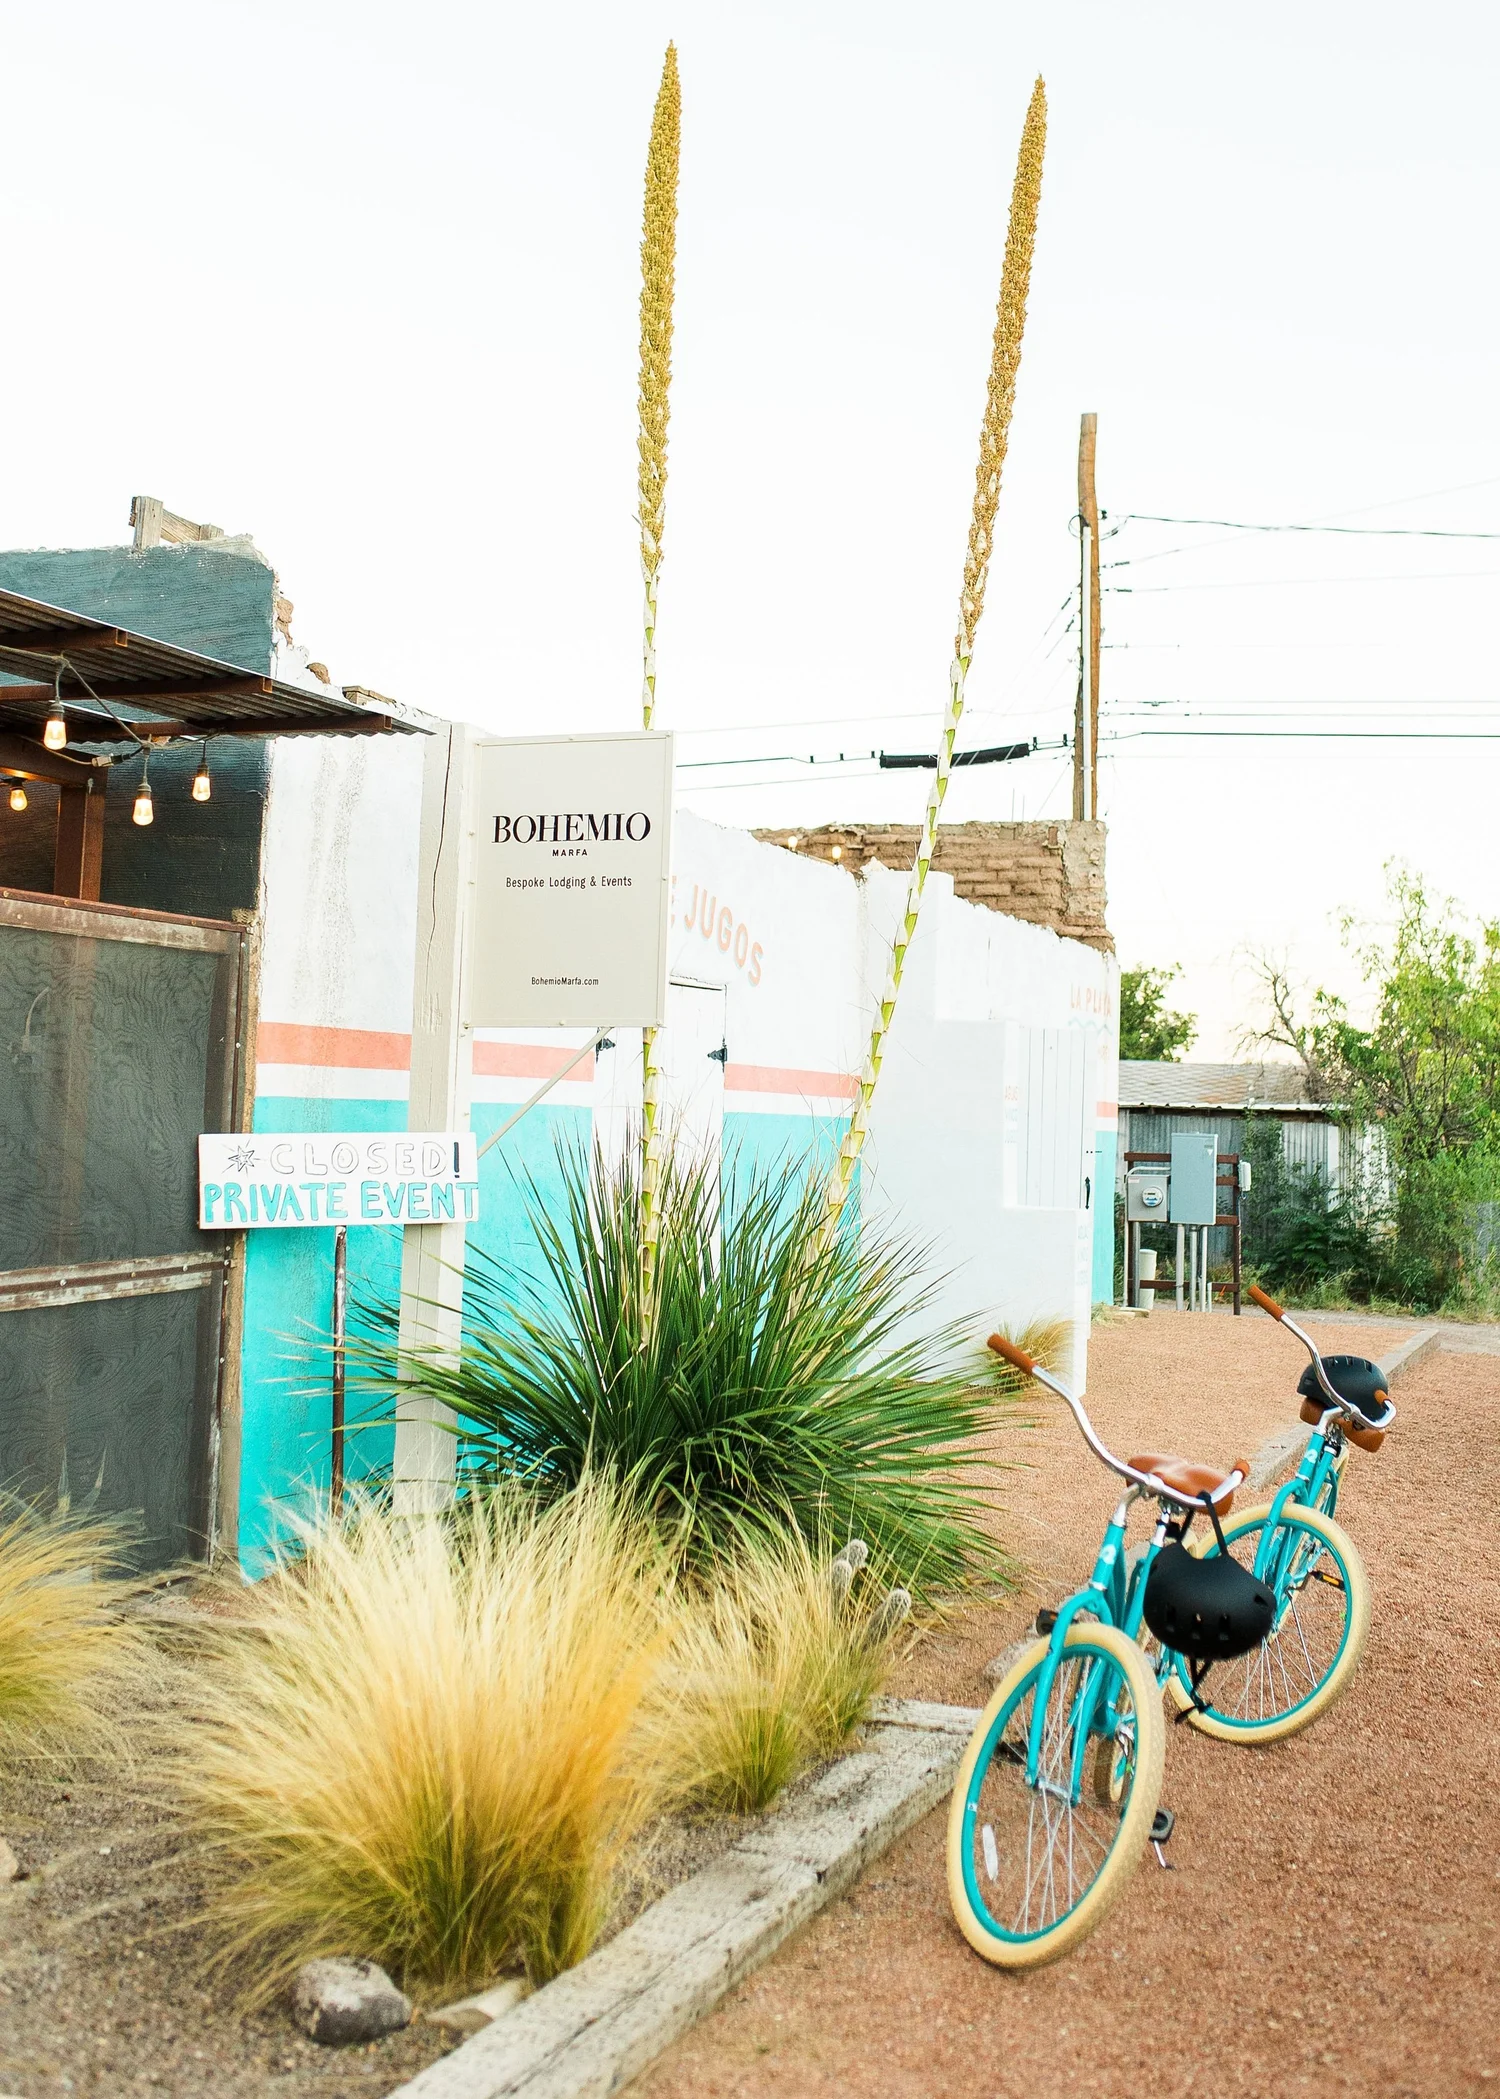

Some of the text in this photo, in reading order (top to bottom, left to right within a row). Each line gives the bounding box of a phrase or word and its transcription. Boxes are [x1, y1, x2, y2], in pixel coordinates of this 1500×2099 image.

[491, 812, 651, 844] BOHEMIO
[552, 849, 588, 857] MARFA
[506, 876, 632, 890] Bespoke Lodging & Events
[684, 884, 764, 986] JUGOS
[531, 976, 599, 986] BohemioMarfa.com
[270, 1141, 460, 1178] CLOSED!
[204, 1181, 479, 1223] PRIVATE EVENT
